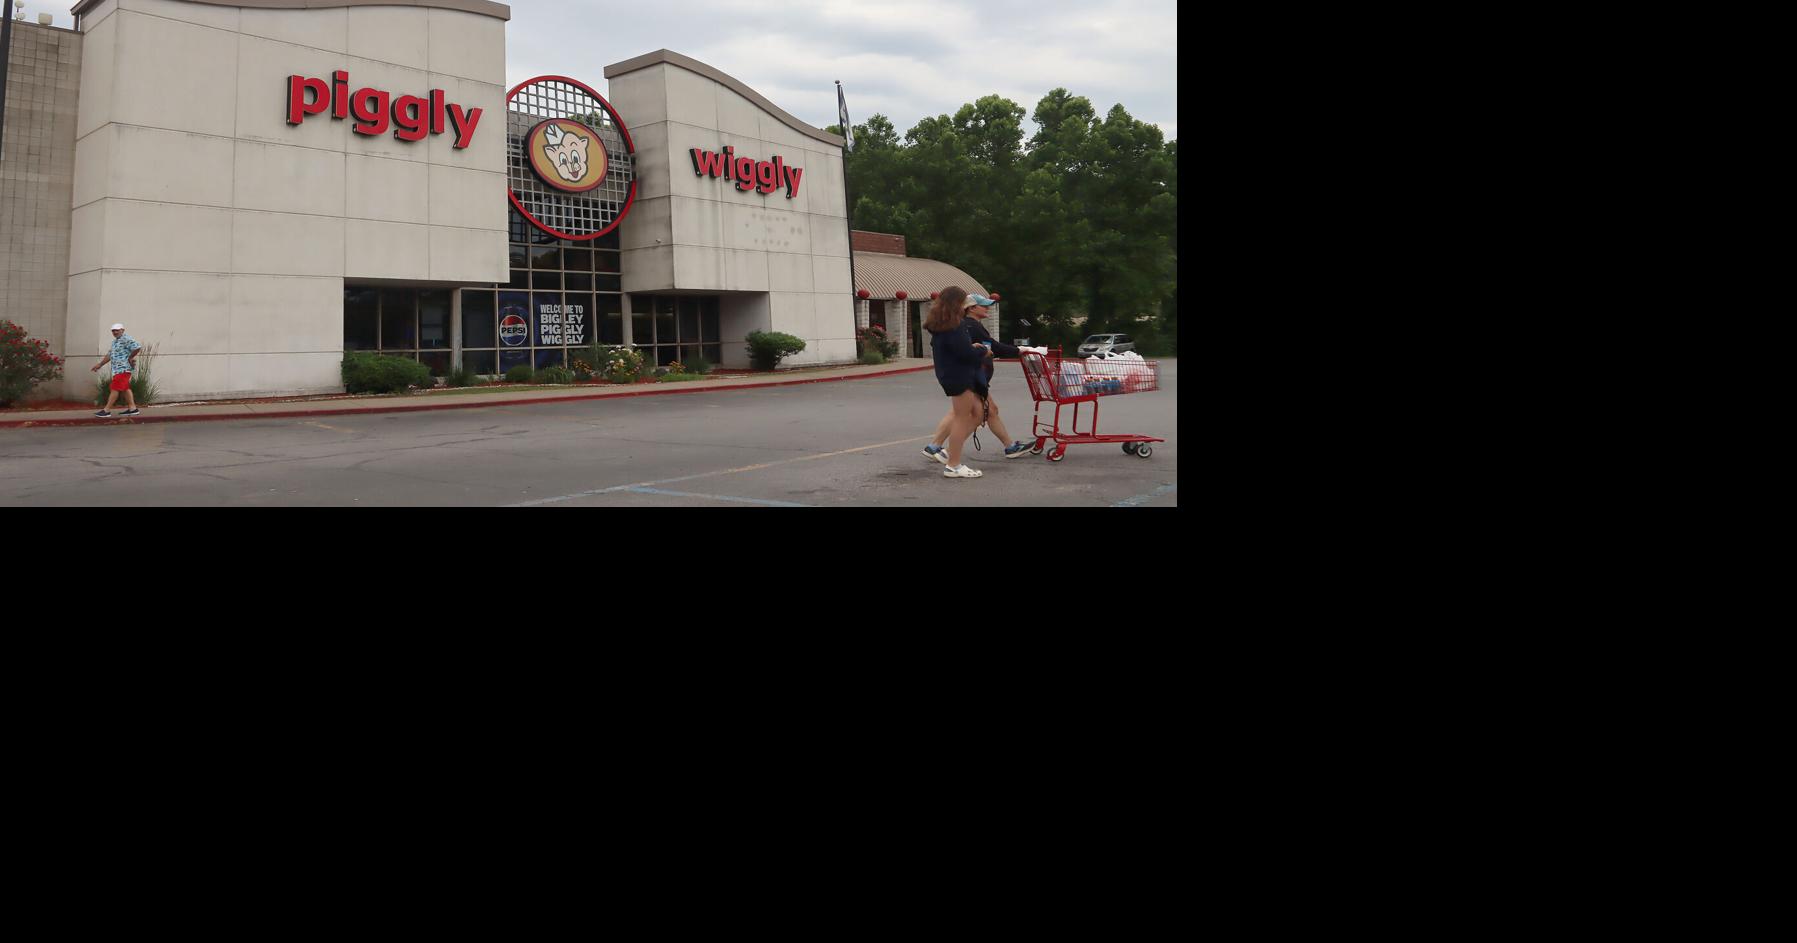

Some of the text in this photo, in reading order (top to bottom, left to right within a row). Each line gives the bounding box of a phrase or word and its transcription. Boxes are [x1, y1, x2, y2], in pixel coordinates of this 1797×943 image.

[286, 70, 483, 149] piggly
[689, 145, 803, 199] wiggly
[574, 304, 584, 314] TO
[540, 324, 584, 334] PIGGLY
[541, 335, 584, 344] WIGGLY
